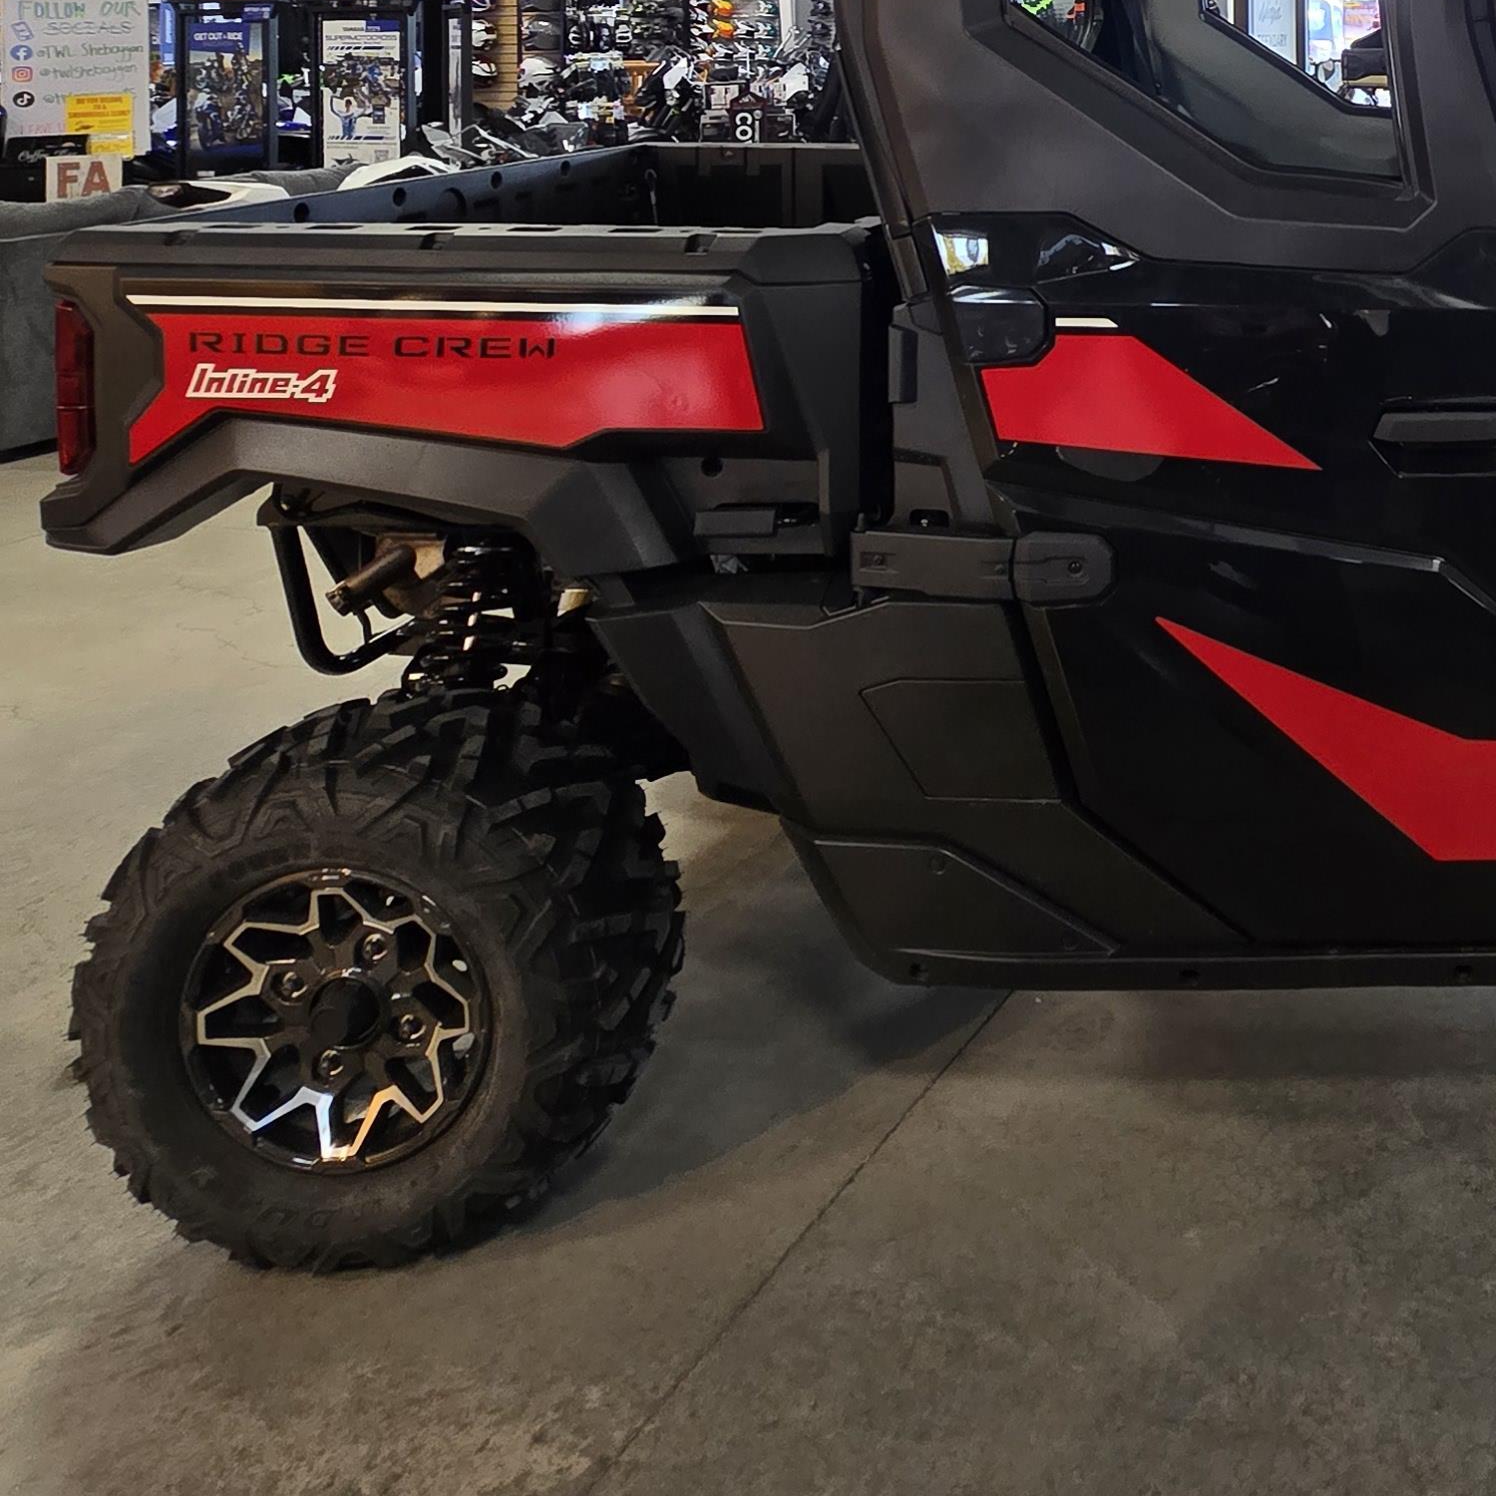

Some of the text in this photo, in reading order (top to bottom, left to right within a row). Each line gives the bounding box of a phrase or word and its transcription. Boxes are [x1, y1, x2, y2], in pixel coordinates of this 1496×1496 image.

[18, 0, 142, 20] FOLLOW OUR
[43, 20, 136, 36] SOCIALS
[57, 160, 111, 199] FA
[189, 332, 556, 360] RIDGE CREW
[186, 363, 340, 403] Inline-4
